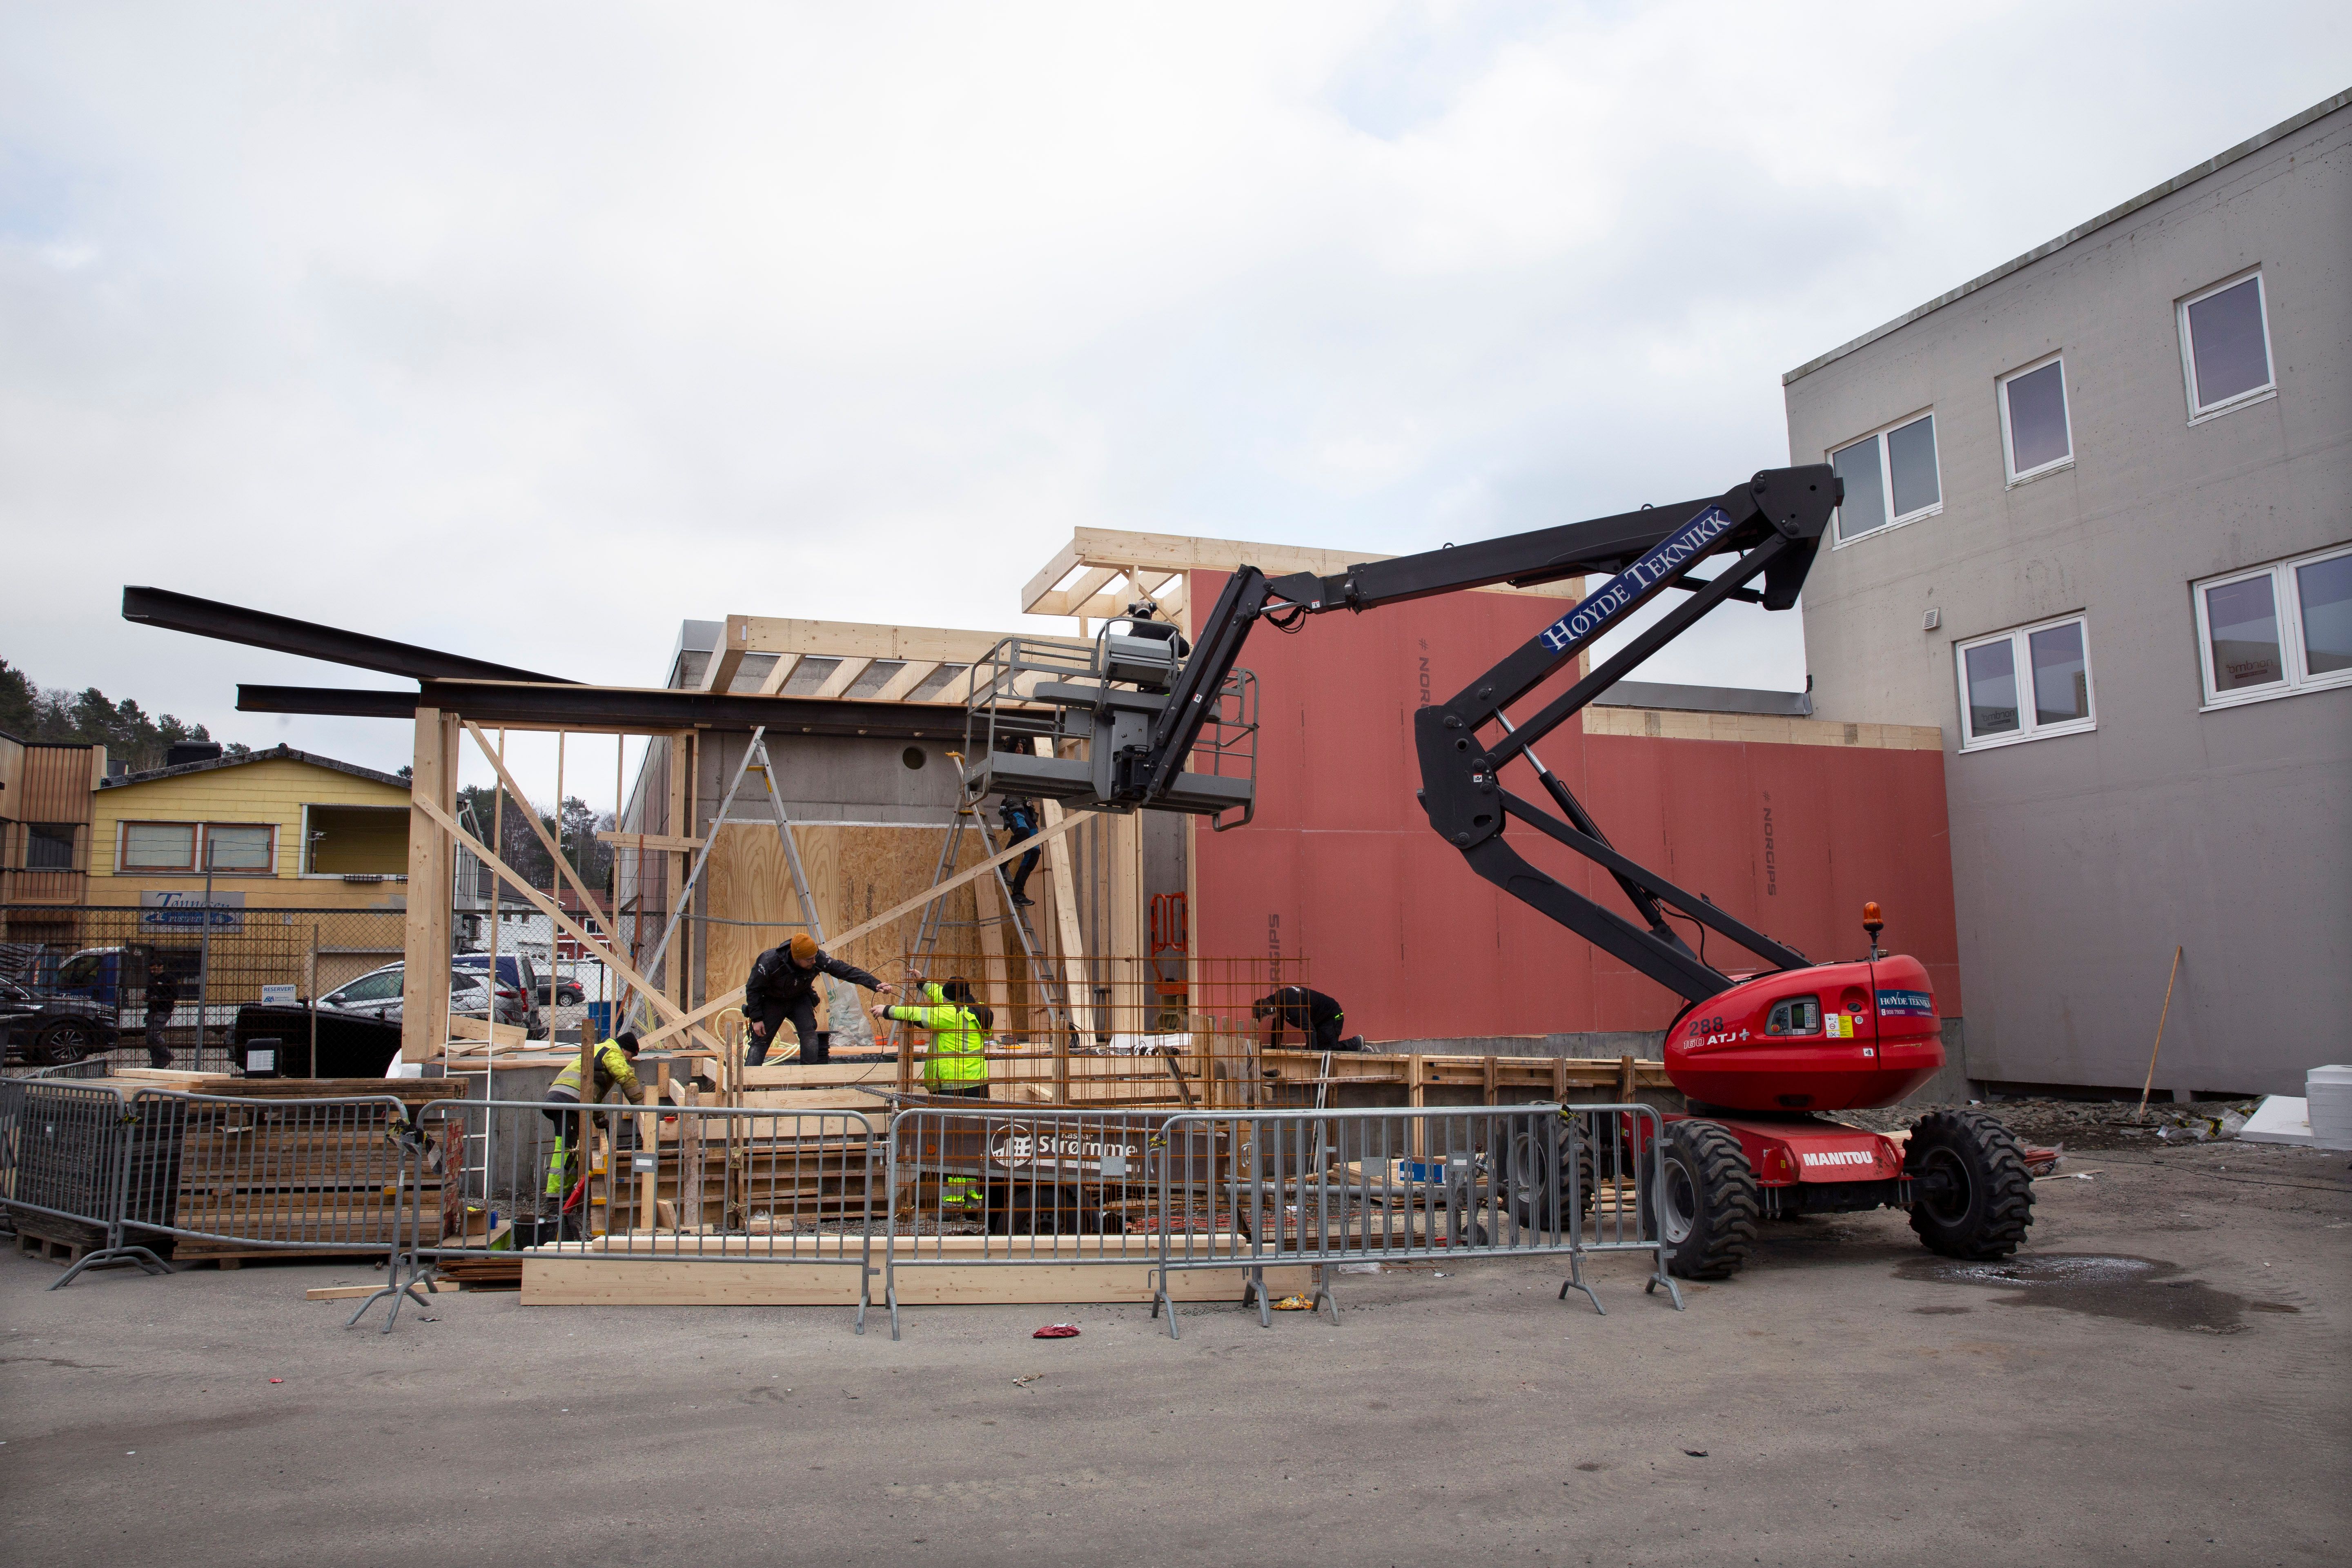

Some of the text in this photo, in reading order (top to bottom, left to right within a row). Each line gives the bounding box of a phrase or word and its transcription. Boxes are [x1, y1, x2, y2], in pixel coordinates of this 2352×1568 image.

[1544, 509, 1731, 650] HØYDE TEKNIKK
[1419, 657, 1431, 707] NOR
[1763, 808, 1777, 895] NORGIPS
[1268, 914, 1280, 995] ORGIPS
[1880, 992, 1908, 1005] HØYDE
[1689, 1016, 1724, 1036] 288
[1684, 1037, 1704, 1049] 160
[1061, 1132, 1093, 1140] Kasar
[1038, 1136, 1138, 1157] Strømme
[1802, 1151, 1873, 1166] MANITOU
